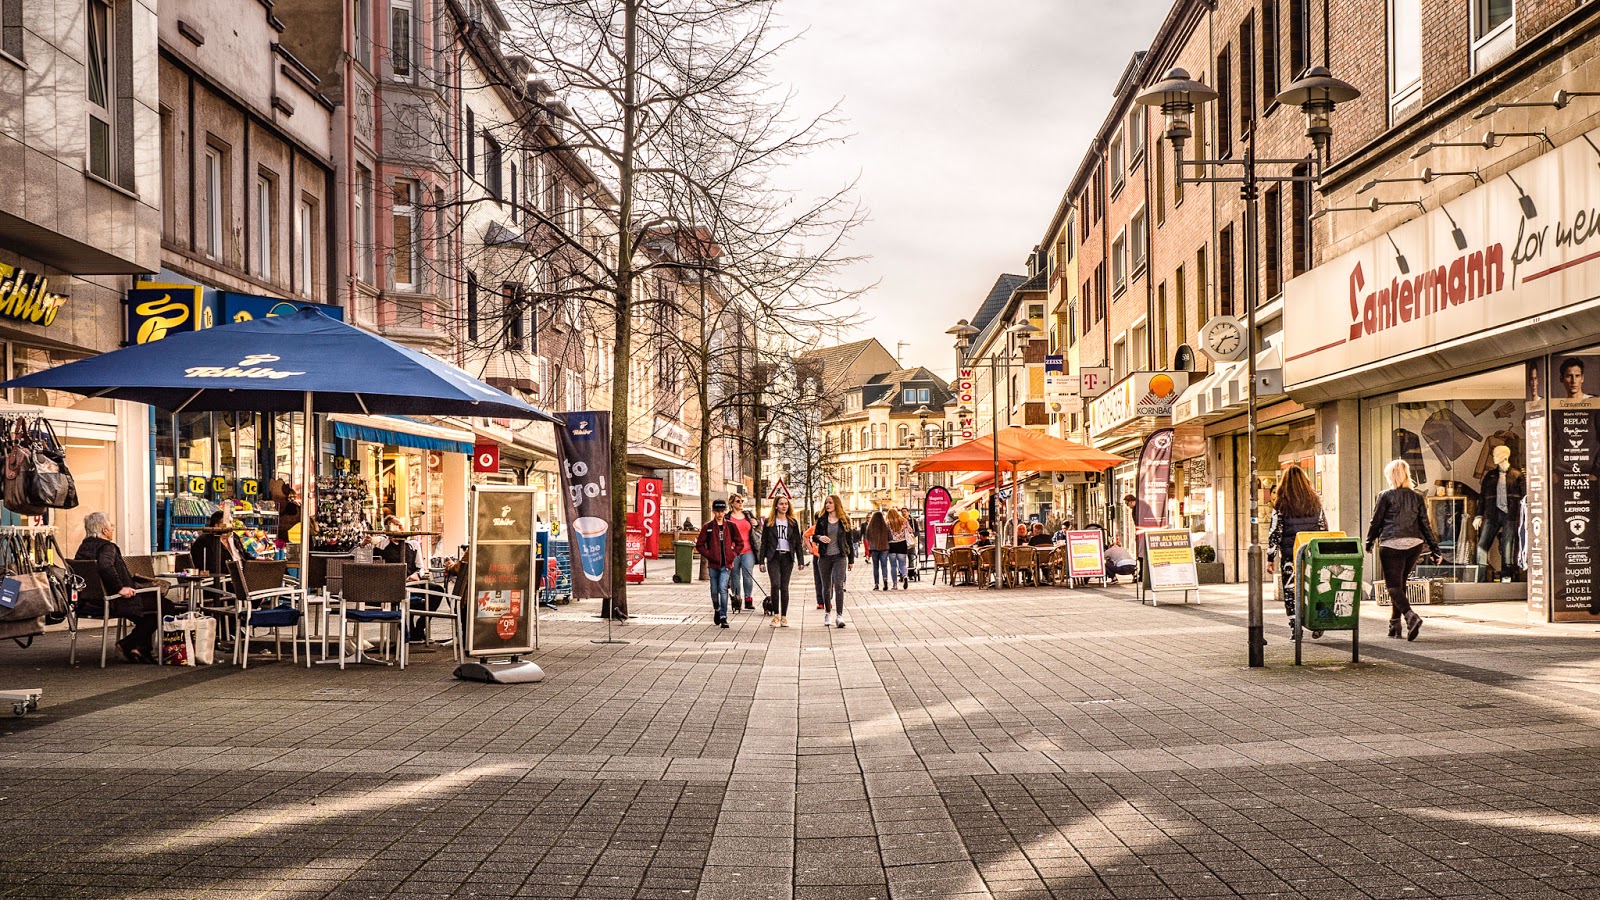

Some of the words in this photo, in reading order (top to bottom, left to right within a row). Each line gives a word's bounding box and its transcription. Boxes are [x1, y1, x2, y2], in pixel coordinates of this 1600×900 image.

[1511, 215, 1548, 290] for
[184, 367, 306, 379] Tchibo
[1137, 407, 1172, 415] KORNBAC
[564, 458, 588, 479] to
[569, 475, 607, 507] go!
[1162, 534, 1188, 542] ALTGOLD
[1565, 566, 1591, 577] bugatti
